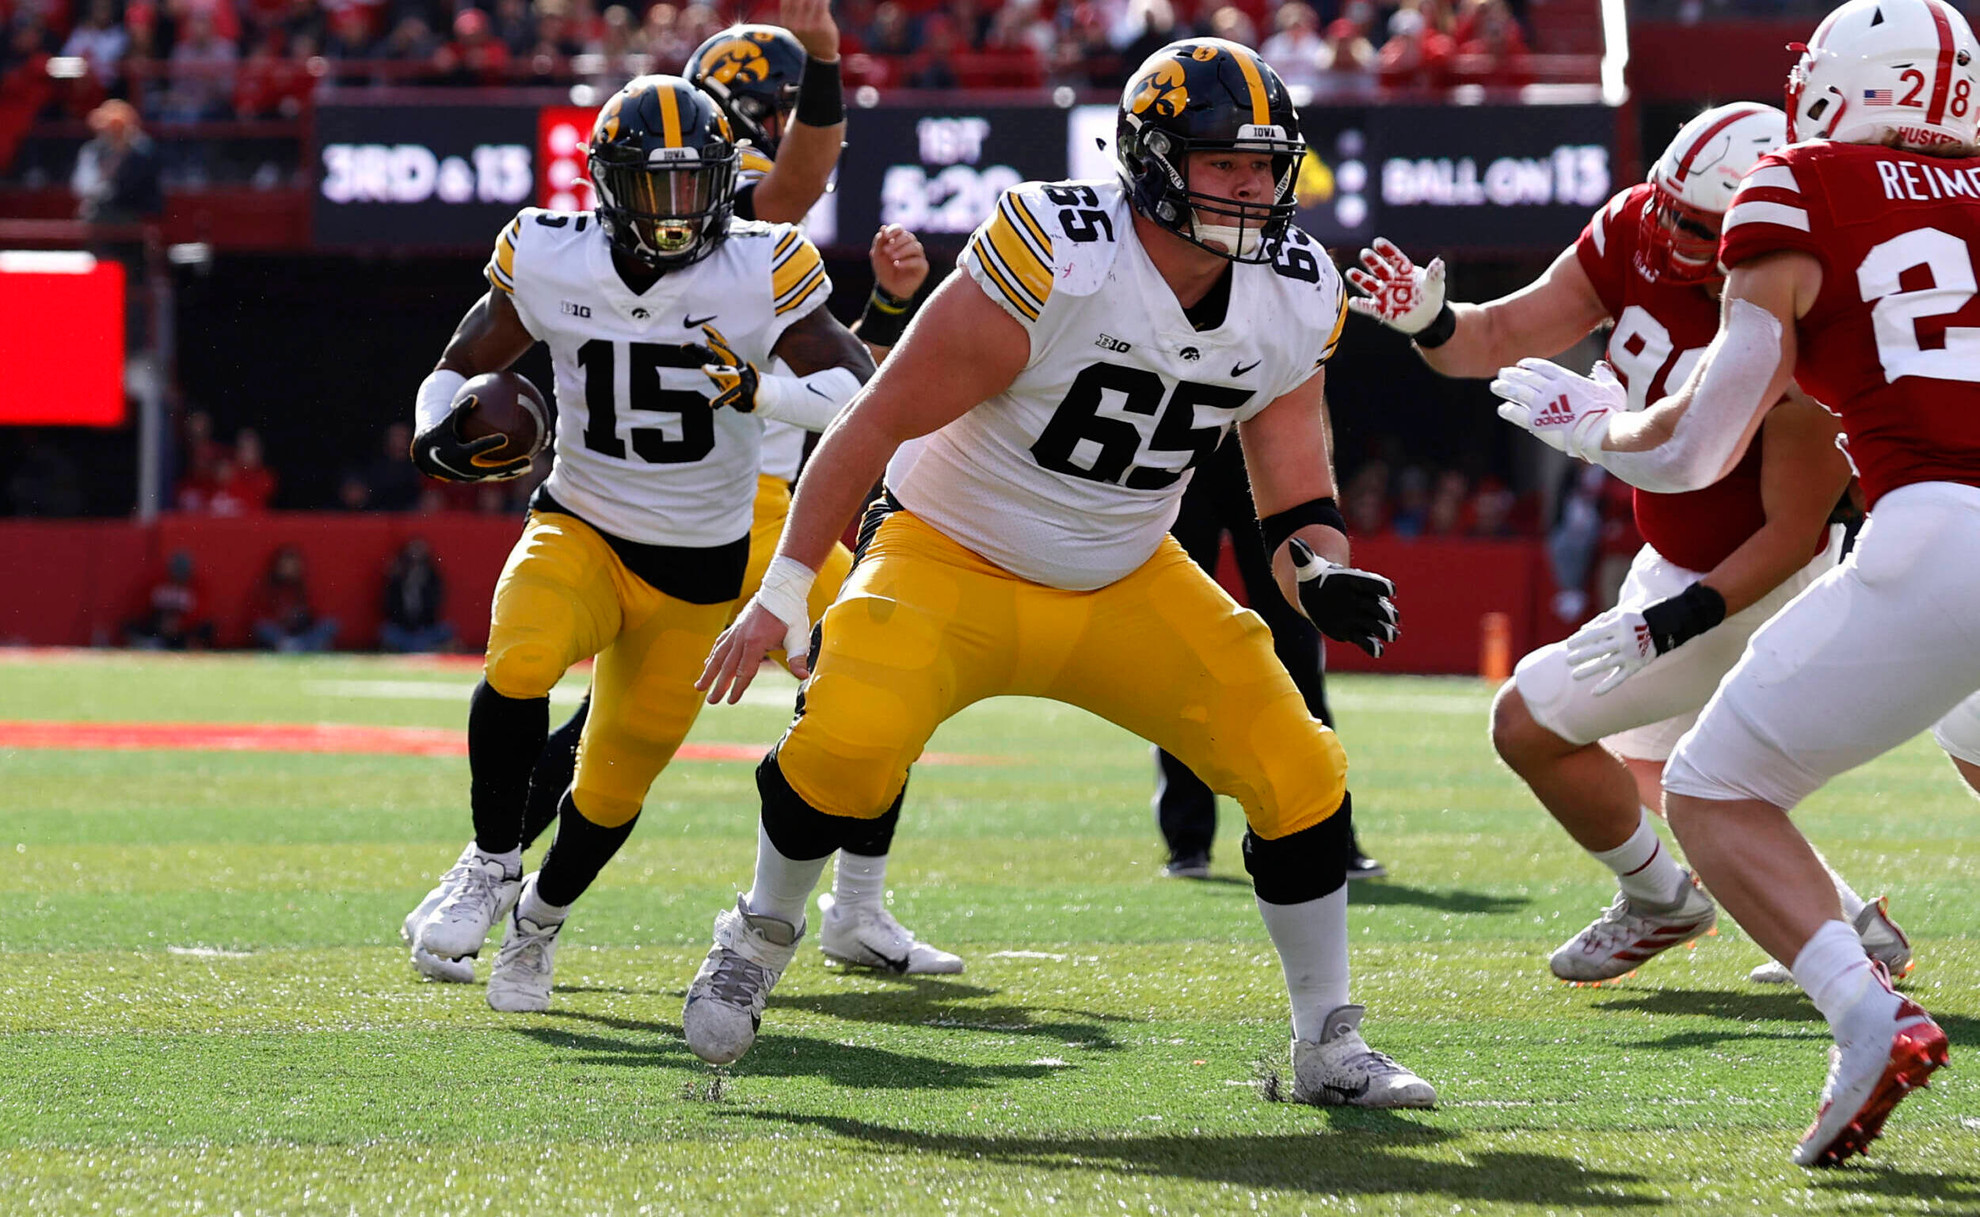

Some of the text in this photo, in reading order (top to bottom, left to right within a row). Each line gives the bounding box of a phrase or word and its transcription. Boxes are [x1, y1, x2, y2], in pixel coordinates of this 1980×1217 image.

[664, 150, 686, 160] IOWA
[916, 117, 991, 165] 1ST
[1253, 126, 1276, 138] IOWA
[1898, 126, 1962, 146] HUSKE
[321, 143, 438, 204] 3RD
[472, 143, 533, 204] 13
[1382, 144, 1610, 206] BALL ON 13
[1040, 185, 1115, 242] 65
[1856, 227, 1980, 383] 2
[577, 338, 715, 464] 15
[1028, 361, 1257, 491] 65
[1534, 414, 1575, 427] adidas
